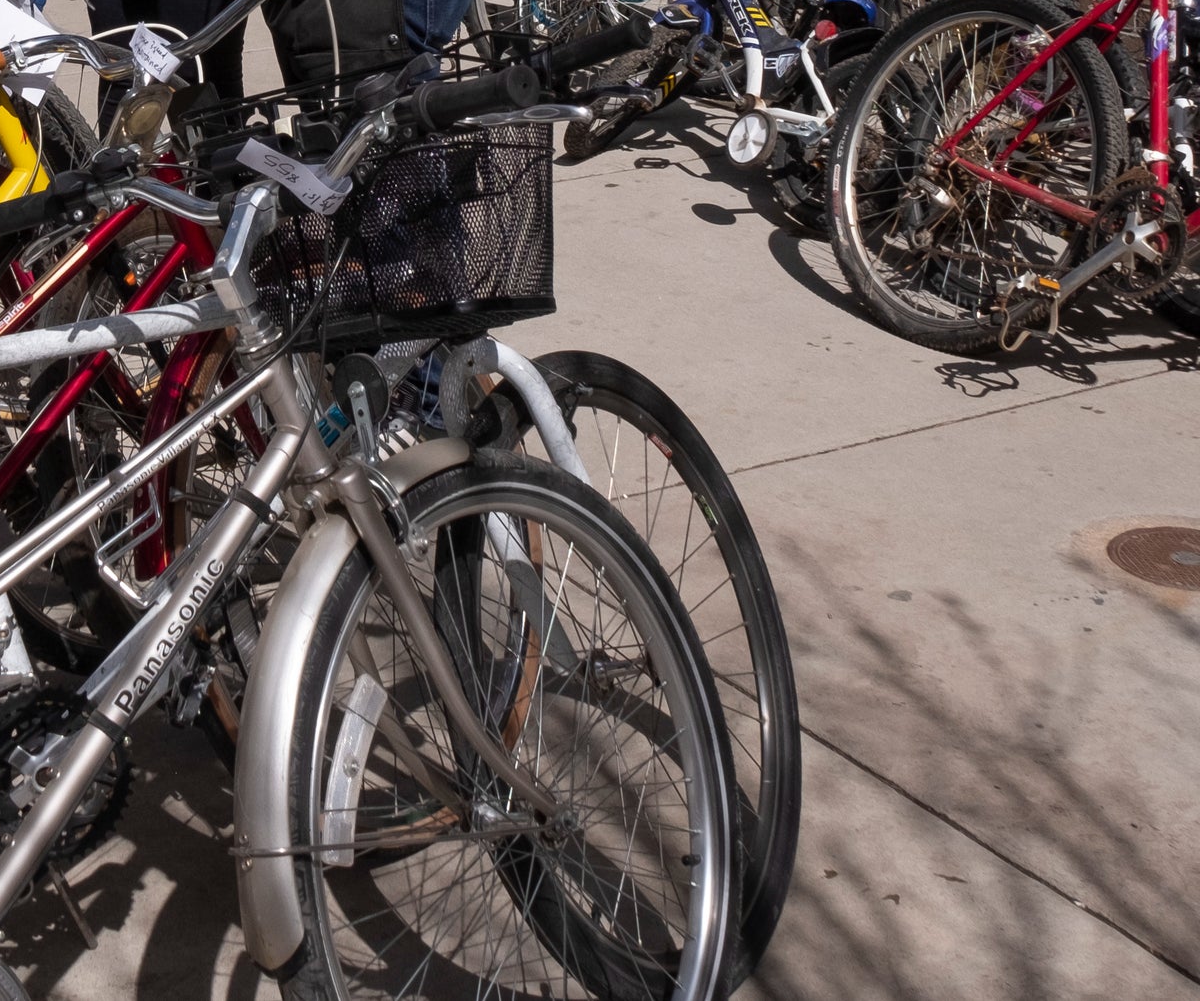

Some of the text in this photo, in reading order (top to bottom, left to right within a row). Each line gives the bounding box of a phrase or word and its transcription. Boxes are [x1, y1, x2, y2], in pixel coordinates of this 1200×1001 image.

[264, 154, 300, 184] $55
[97, 465, 155, 512] Panasonic
[157, 430, 202, 467] Villager
[113, 559, 225, 717] Panasonic
